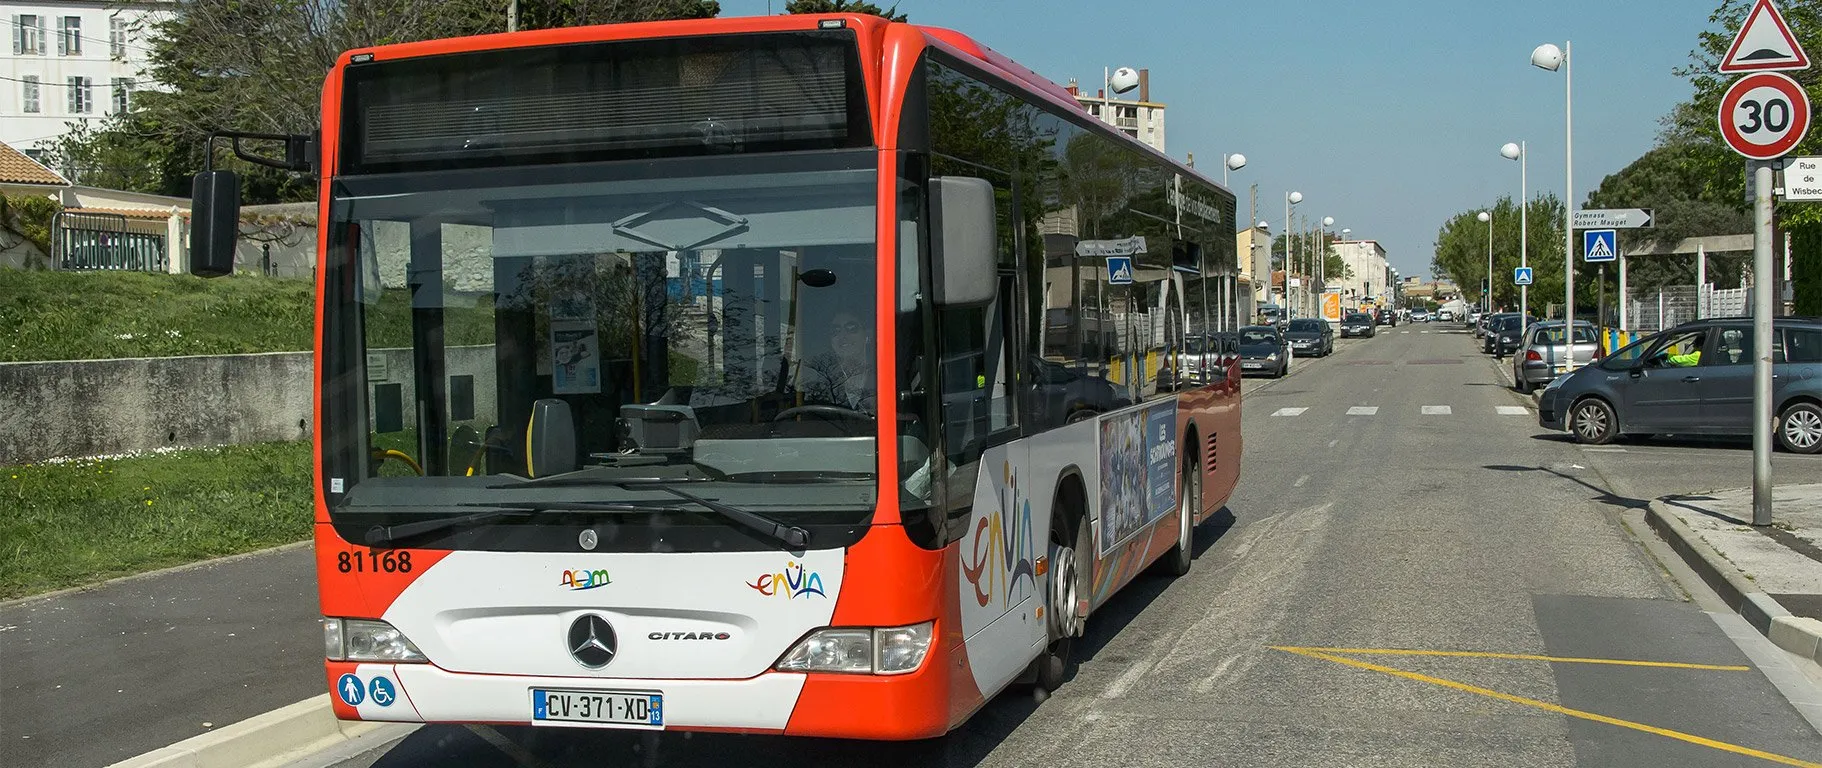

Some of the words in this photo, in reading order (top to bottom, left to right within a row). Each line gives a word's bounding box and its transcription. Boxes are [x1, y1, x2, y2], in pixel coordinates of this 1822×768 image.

[1739, 98, 1790, 134] 30
[1799, 162, 1816, 170] Rue
[1574, 212, 1605, 221] Gymnase
[338, 551, 412, 573] 81168
[648, 632, 731, 640] CITARO
[548, 695, 648, 720] CV-371-XD
[652, 711, 660, 721] 13
